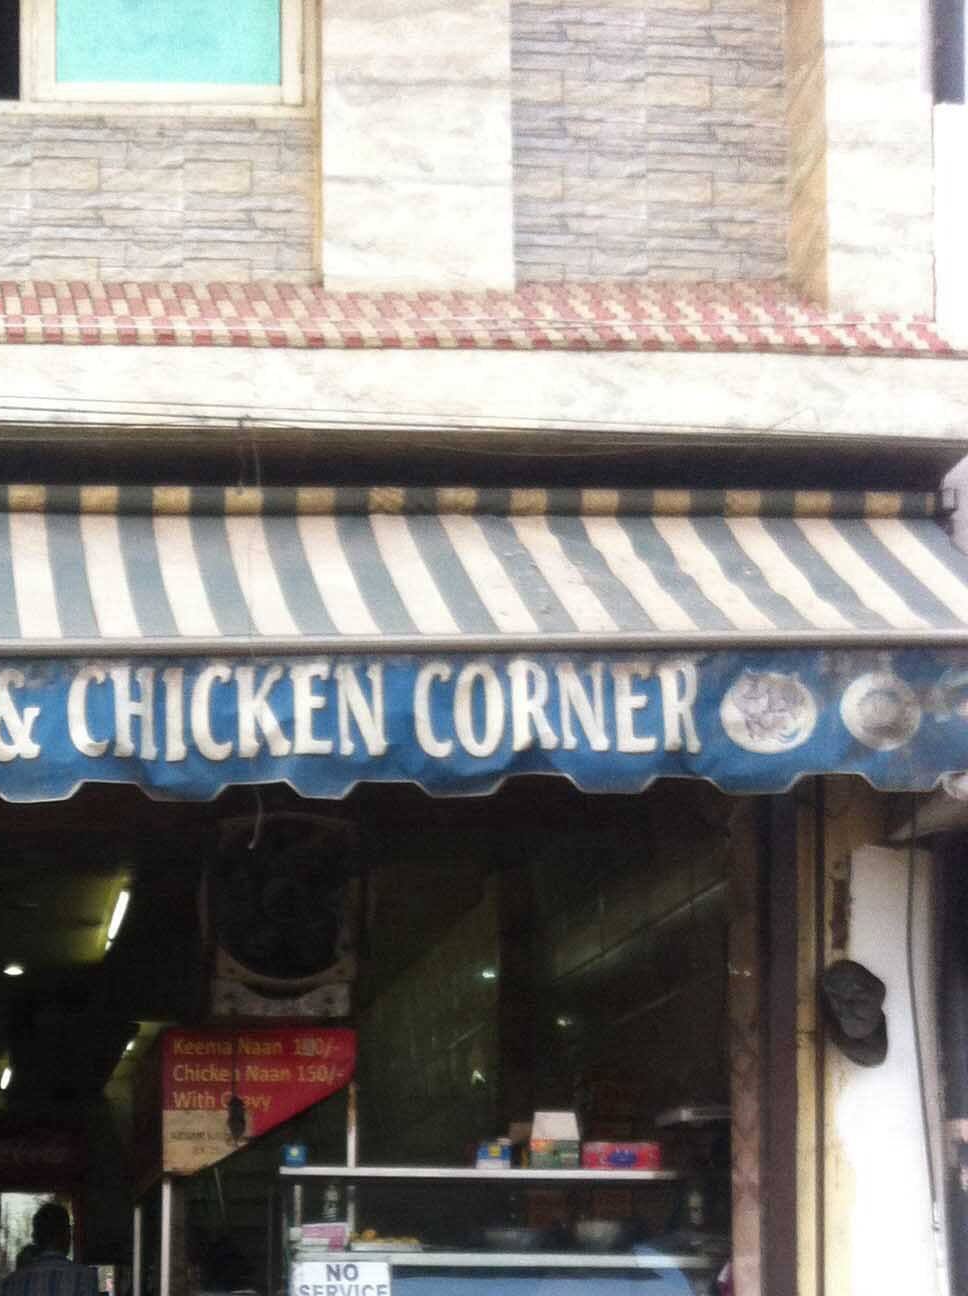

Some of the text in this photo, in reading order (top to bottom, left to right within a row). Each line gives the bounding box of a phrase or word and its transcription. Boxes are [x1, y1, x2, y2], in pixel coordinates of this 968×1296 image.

[67, 662, 388, 763] CHICKEN
[413, 659, 701, 757] CORNER
[173, 1038, 232, 1056] Keema
[238, 1037, 283, 1056] Naan
[246, 1065, 291, 1083] Naan
[173, 1091, 215, 1109] With
[326, 1264, 359, 1281] NO
